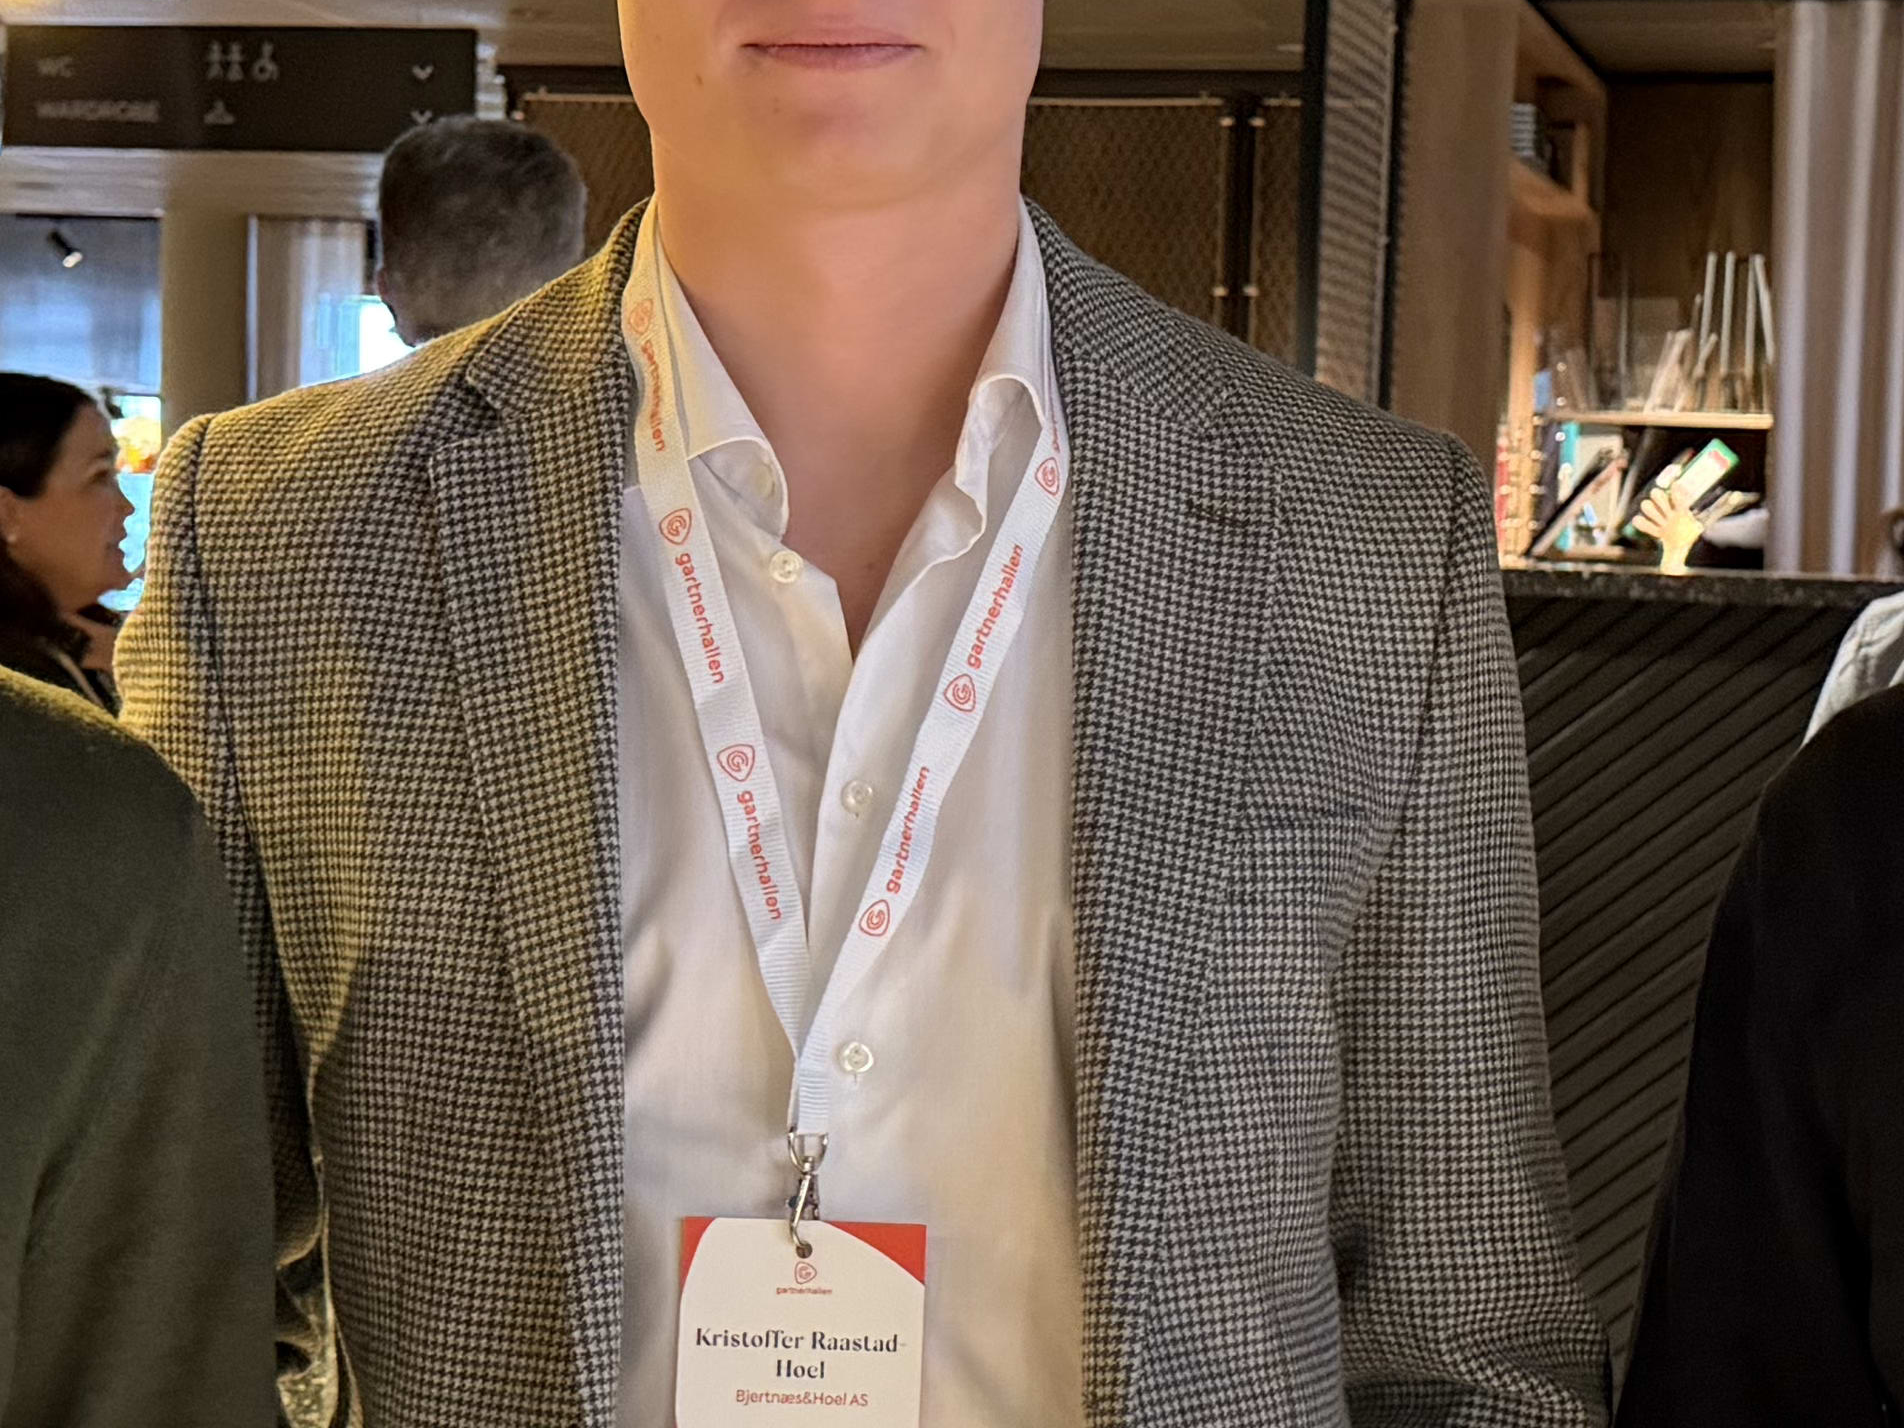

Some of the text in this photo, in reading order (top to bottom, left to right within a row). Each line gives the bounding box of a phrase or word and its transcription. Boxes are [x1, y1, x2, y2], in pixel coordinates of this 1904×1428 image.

[676, 552, 724, 684] gartnerhallen
[967, 543, 1023, 670] gartnerhallen
[737, 790, 782, 920] gartnerhallen
[886, 766, 929, 894] gartnerhallen
[696, 1328, 804, 1349] Kristoffer
[736, 1389, 869, 1407] Bjertnæs&Hoel AS
[776, 1359, 825, 1379] Hoel
